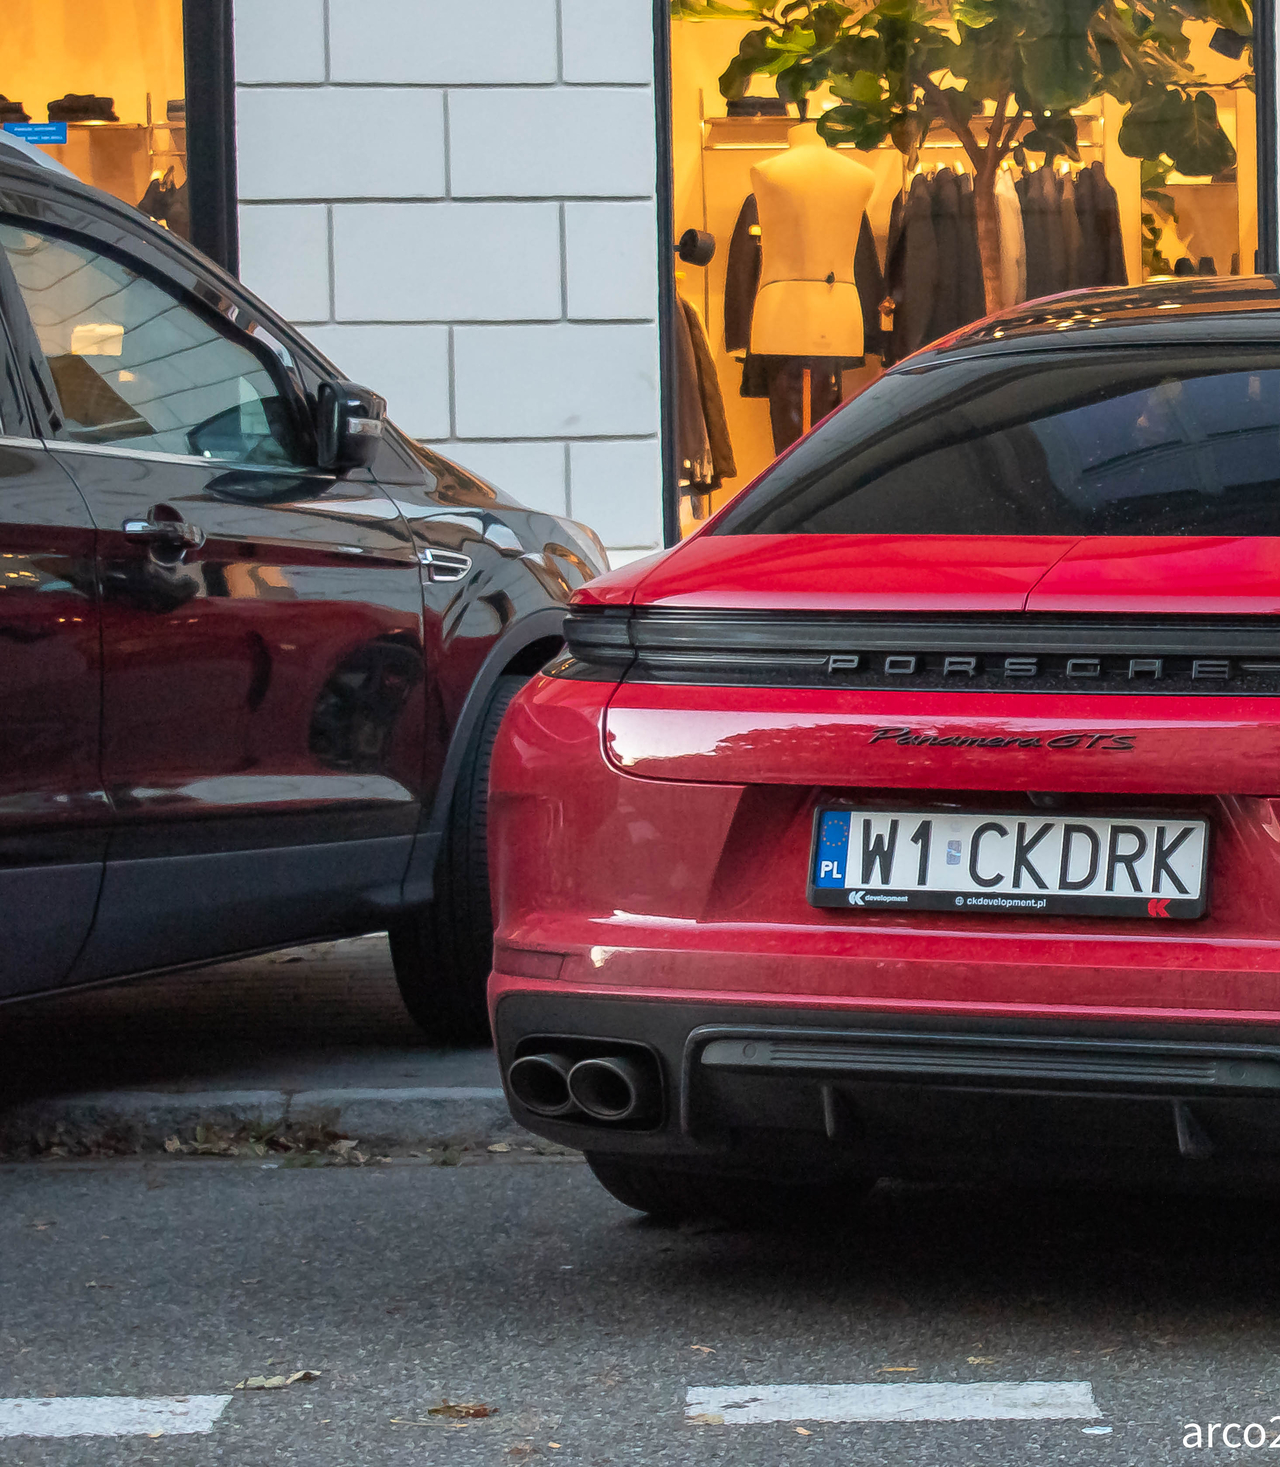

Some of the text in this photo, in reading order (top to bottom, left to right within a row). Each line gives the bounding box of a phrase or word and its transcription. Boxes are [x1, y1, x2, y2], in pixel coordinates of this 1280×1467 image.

[828, 655, 1230, 679] PORSCHE
[868, 727, 1138, 751] Panamera GTS
[860, 818, 1196, 895] W1 CKDRK
[820, 860, 842, 880] PL
[865, 895, 909, 903] development
[966, 897, 1047, 909] ckdevelopment.pl
